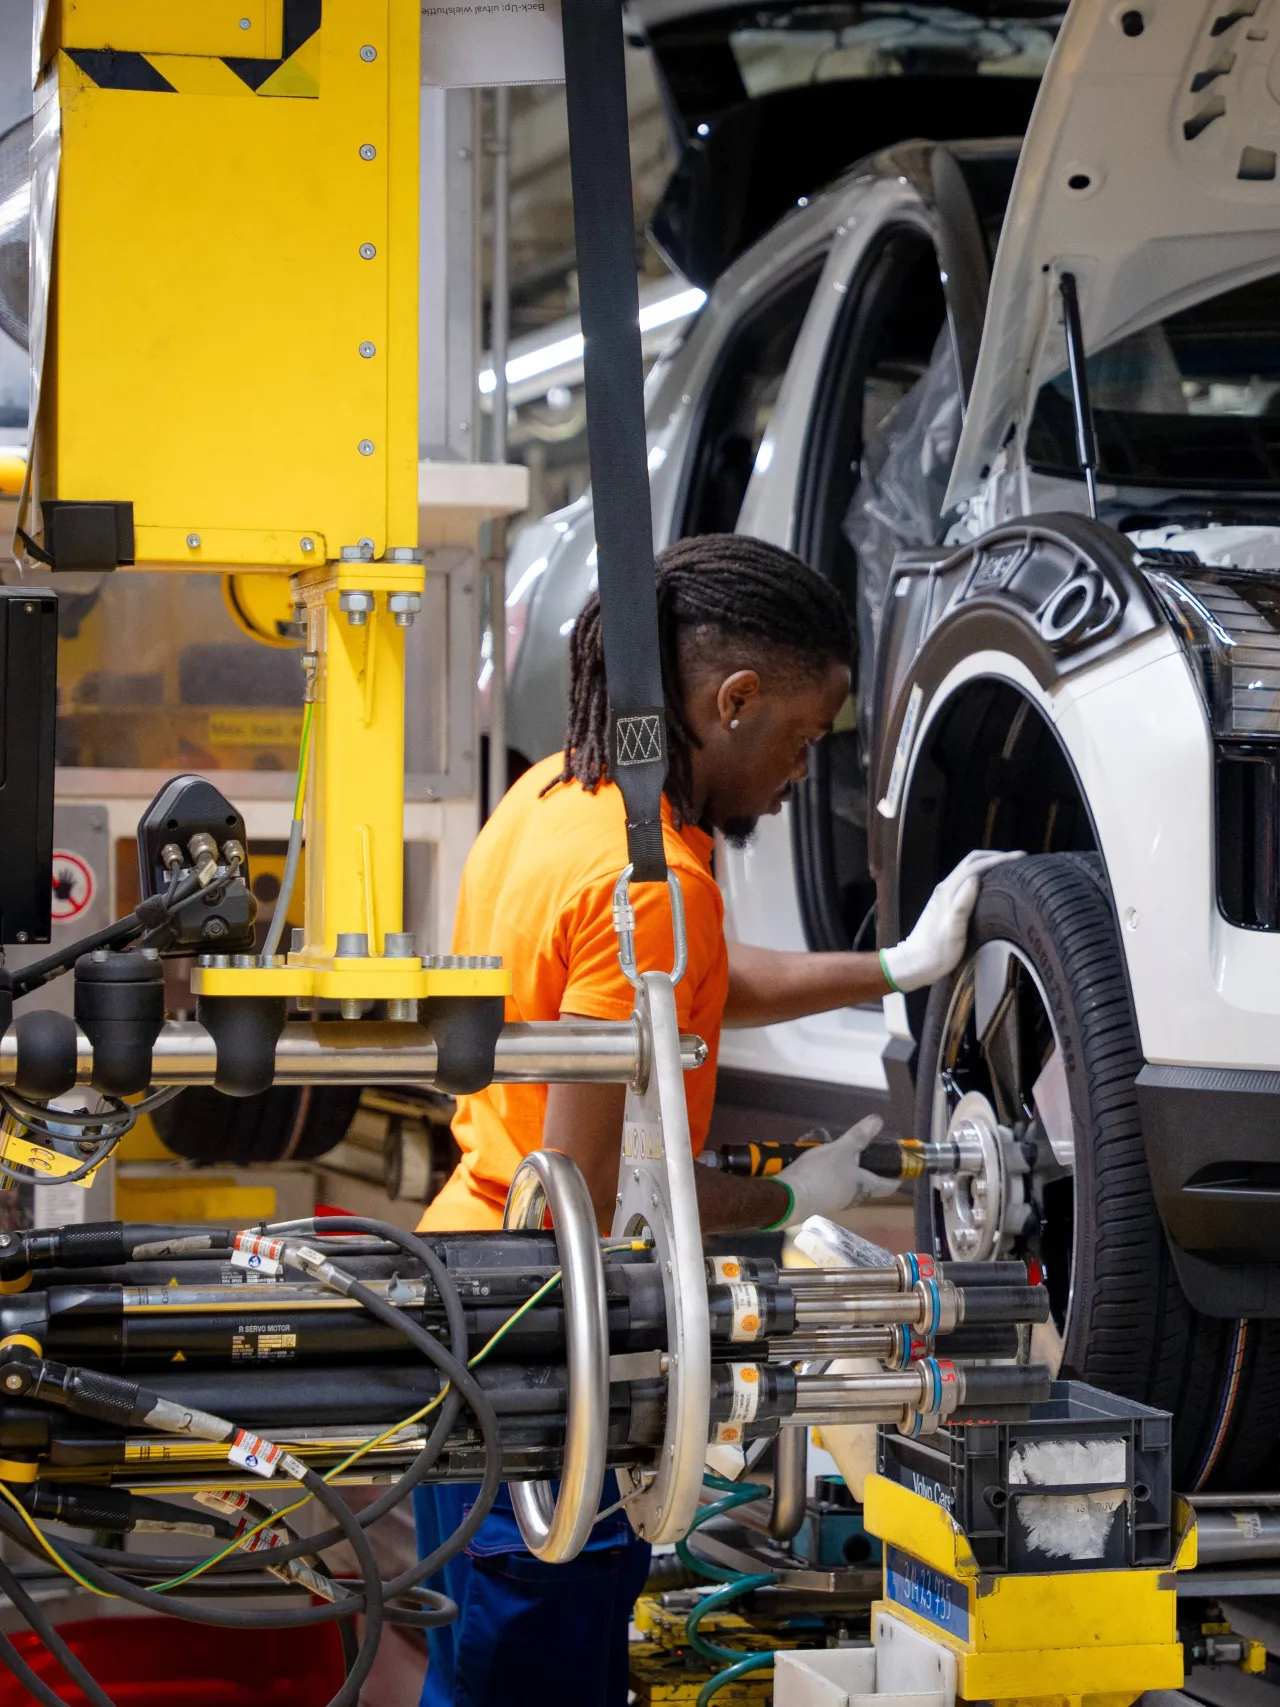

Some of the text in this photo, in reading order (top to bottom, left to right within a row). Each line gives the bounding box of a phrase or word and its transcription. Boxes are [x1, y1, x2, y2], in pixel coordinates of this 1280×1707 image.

[421, 3, 545, 17] Back-Up: uitval wielshuttle
[244, 1325, 267, 1333] SERVO
[267, 1324, 291, 1332] MOTOR
